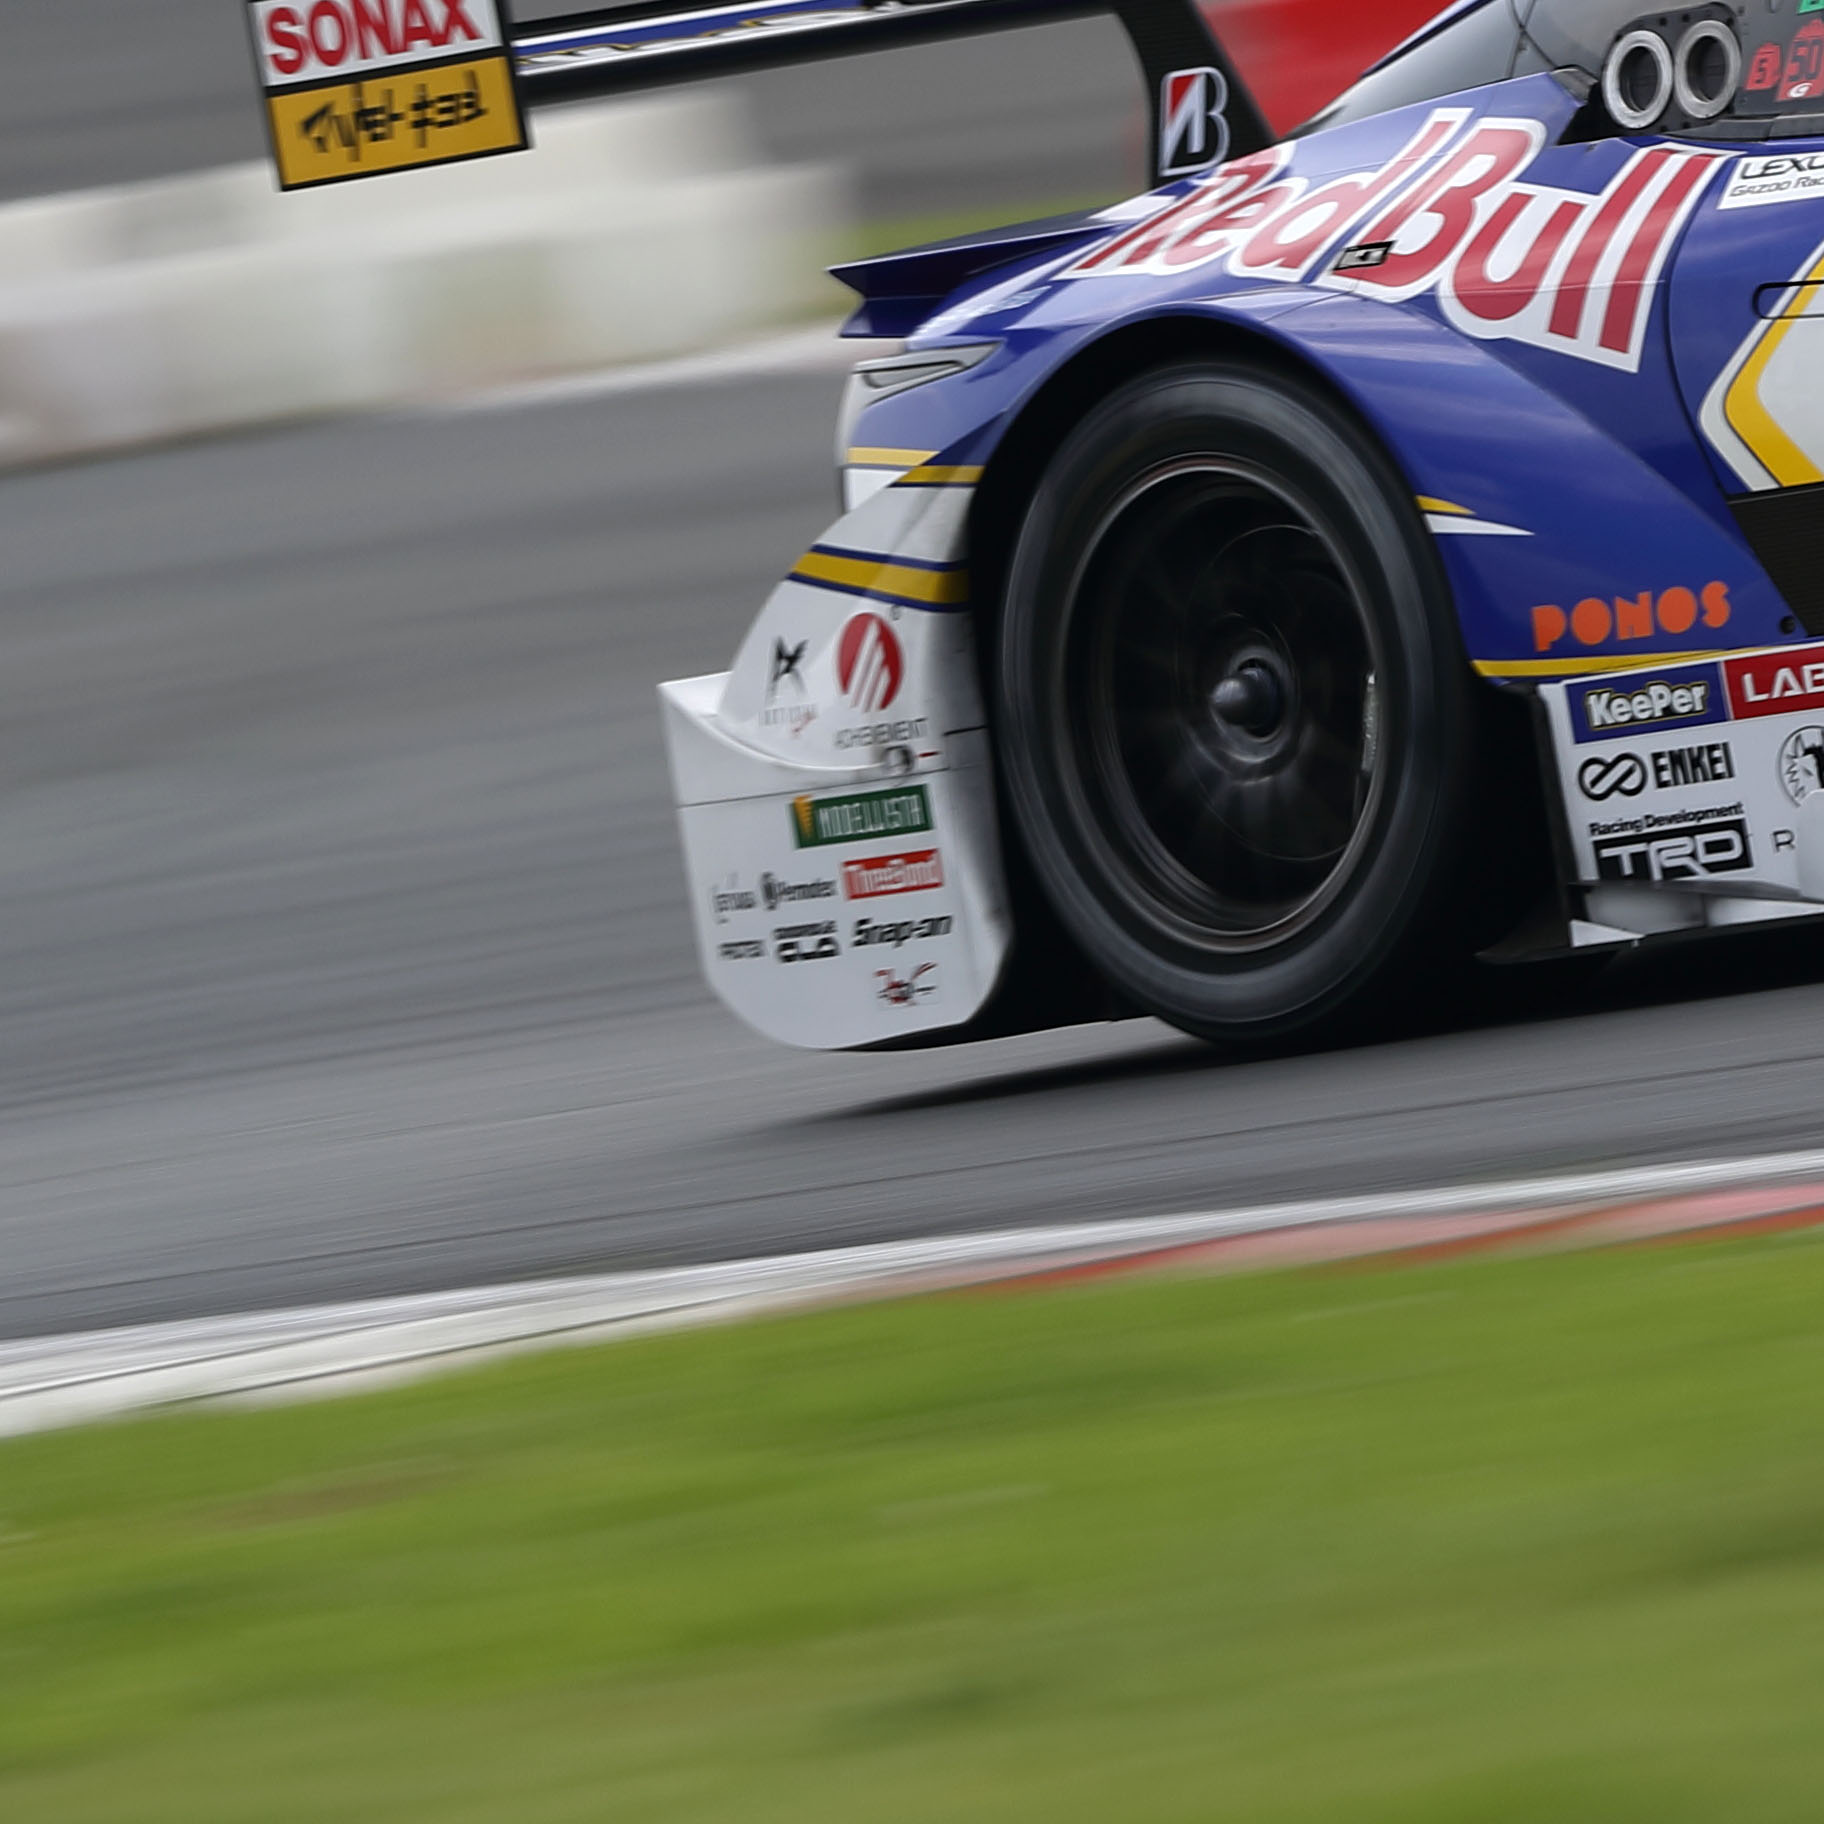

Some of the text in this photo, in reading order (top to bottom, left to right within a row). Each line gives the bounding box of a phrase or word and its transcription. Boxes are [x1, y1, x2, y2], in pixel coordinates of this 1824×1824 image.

[1055, 108, 1746, 373] Red Bull
[1530, 580, 1731, 652] PONOS
[1586, 680, 1709, 731] KeePer
[1651, 742, 1736, 789] ENKEI
[1589, 801, 1744, 836] Racing Development
[1599, 829, 1744, 881] TRD
